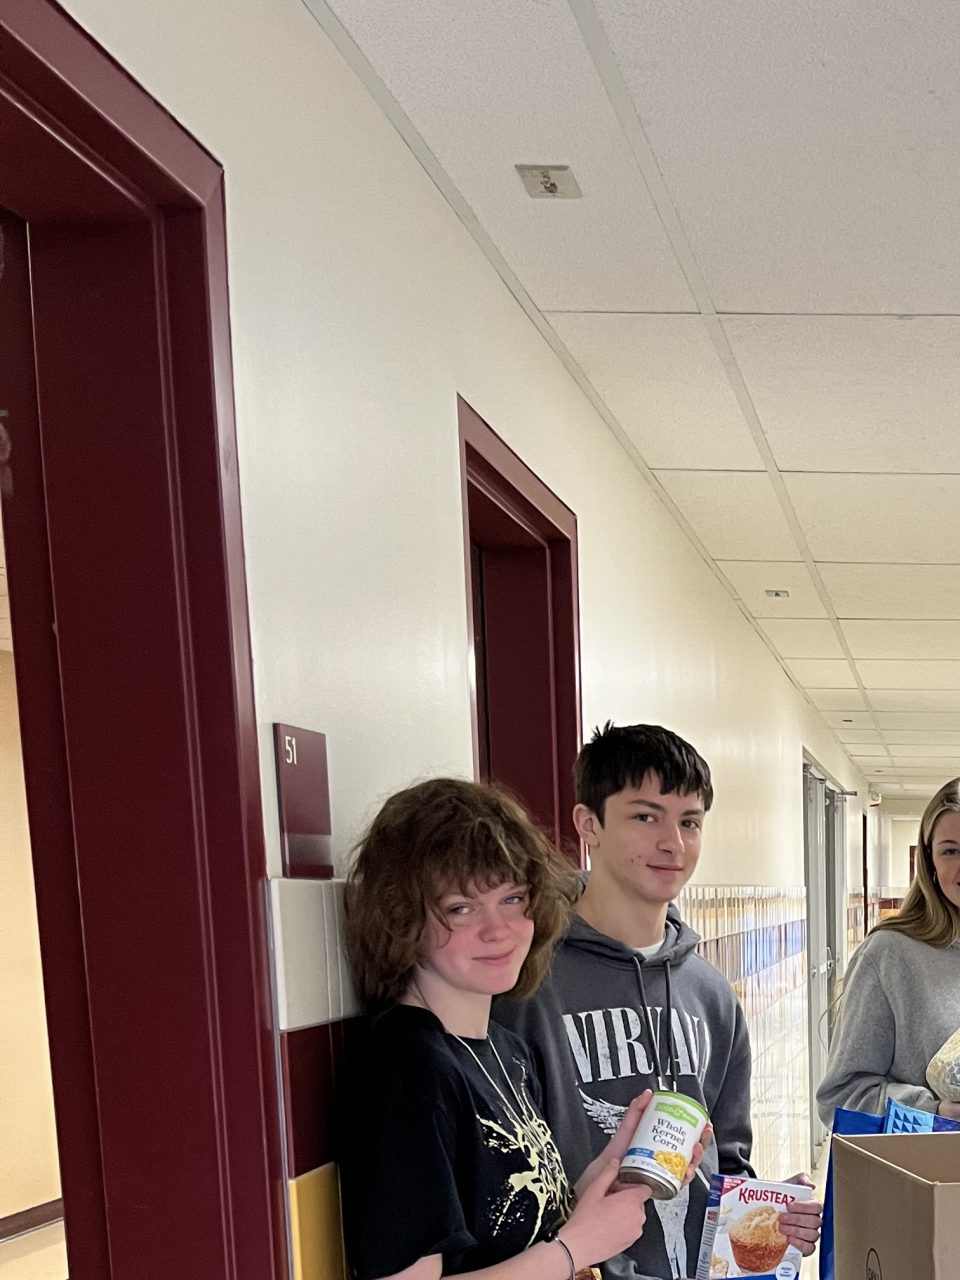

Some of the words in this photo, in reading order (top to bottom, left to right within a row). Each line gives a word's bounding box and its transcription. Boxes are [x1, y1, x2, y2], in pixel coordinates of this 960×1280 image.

[285, 735, 297, 765] 51
[651, 1125, 685, 1146] Kernel
[657, 1118, 687, 1136] Whole
[652, 1135, 678, 1151] Corn
